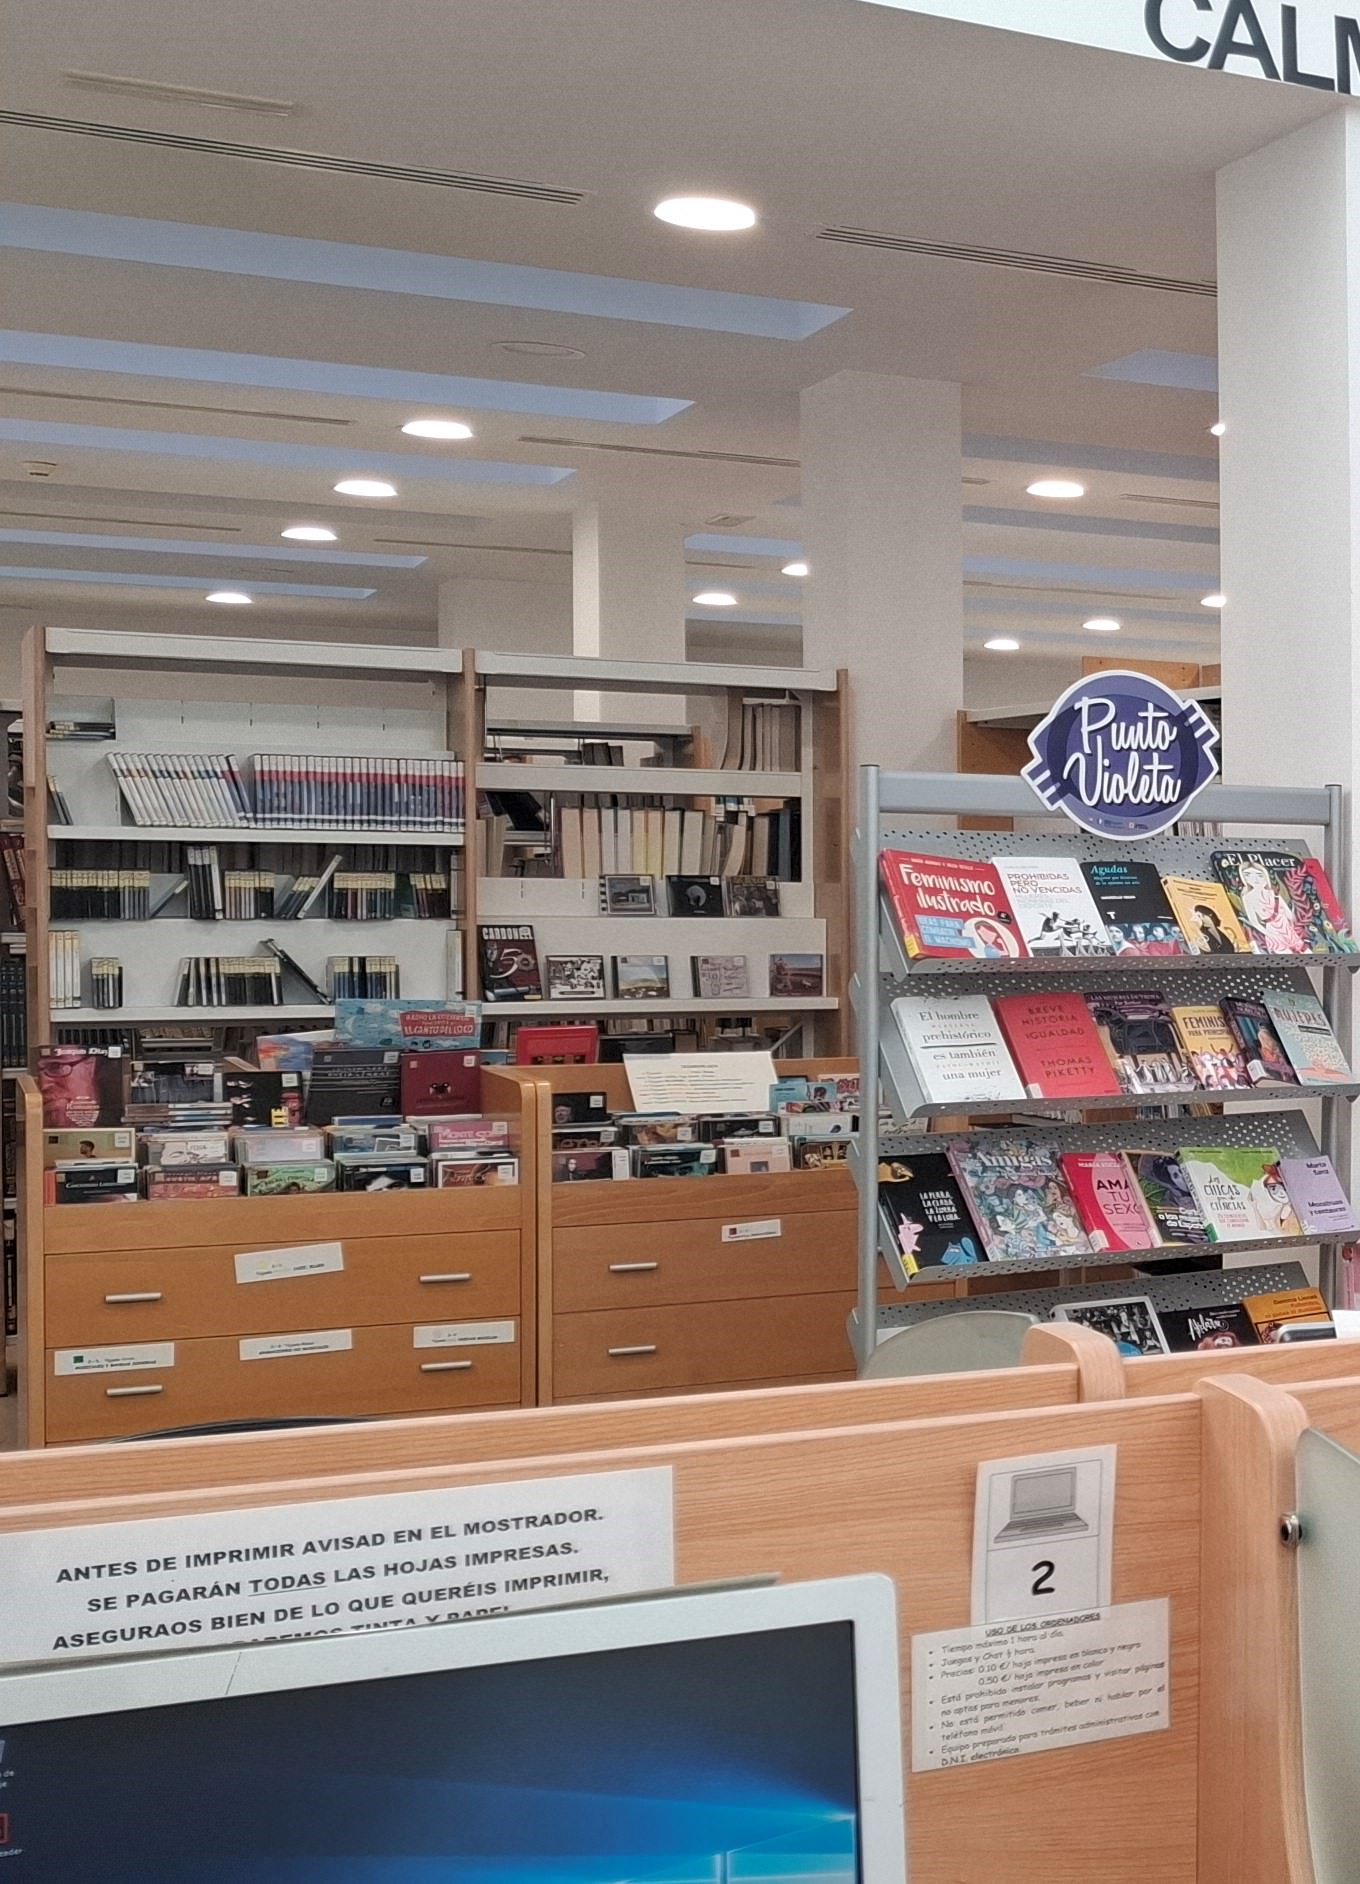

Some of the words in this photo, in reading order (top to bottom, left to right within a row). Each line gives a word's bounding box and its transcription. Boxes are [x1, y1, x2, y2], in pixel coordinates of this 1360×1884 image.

[1074, 697, 1177, 750] Punto
[1062, 736, 1181, 807] Violeta
[1226, 852, 1243, 866] El
[1249, 852, 1296, 868] Placer
[899, 864, 995, 896] Feminismo
[917, 889, 995, 917] ilustrado
[919, 1011, 933, 1022] El
[935, 1010, 980, 1021] hombre
[1028, 1005, 1064, 1014] BREVE
[1022, 1014, 1078, 1025] HISTORIA
[922, 1029, 992, 1044] prehistórico
[1025, 1028, 1085, 1040] IGUALDAD
[949, 1049, 996, 1060] también
[1041, 1056, 1092, 1066] THOMAS
[967, 1069, 1001, 1082] mujer
[1046, 1067, 1095, 1078] PIKETTY
[55, 1560, 138, 1583] ANTES
[145, 1555, 177, 1573] DE
[184, 1542, 295, 1569] IMPRIMIR
[301, 1532, 386, 1555] AVISAD
[392, 1527, 422, 1544] EN
[429, 1524, 457, 1540] EL
[462, 1507, 603, 1536] MOSTRADOR.
[86, 1595, 118, 1613] SE
[125, 1580, 241, 1608] PAGARÁN
[247, 1570, 326, 1596] TODAS
[333, 1564, 376, 1583] LAS
[382, 1554, 457, 1577] HOJAS
[464, 1541, 579, 1567] IMPRESAS.
[1031, 1560, 1056, 1595] 2
[51, 1618, 202, 1651] ASEGURAOS
[210, 1610, 265, 1631] BIEN
[273, 1605, 304, 1622] DE
[310, 1601, 340, 1618] LO
[347, 1593, 394, 1612] QUE
[400, 1581, 497, 1605] QUERÉIS
[503, 1567, 609, 1593] IMPRIMIR,
